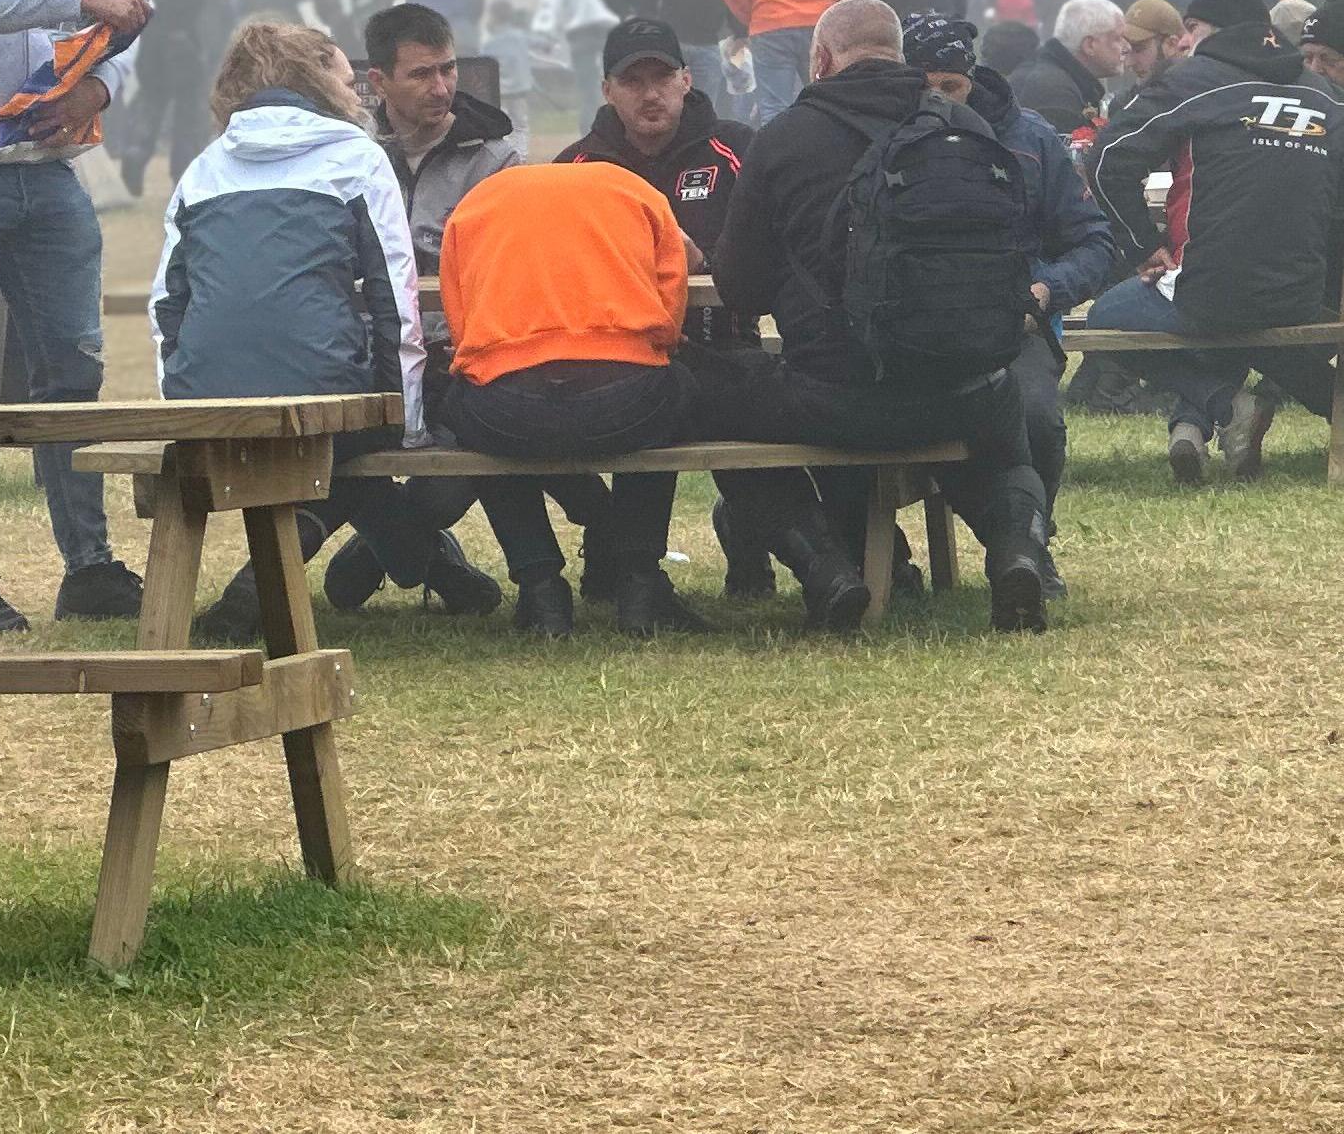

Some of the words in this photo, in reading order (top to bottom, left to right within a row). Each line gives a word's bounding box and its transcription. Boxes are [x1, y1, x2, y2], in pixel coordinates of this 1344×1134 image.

[1251, 95, 1327, 137] TT
[1252, 137, 1281, 147] ISLE
[1285, 140, 1301, 150] OF
[1305, 144, 1328, 156] MAN
[680, 186, 709, 201] TEN
